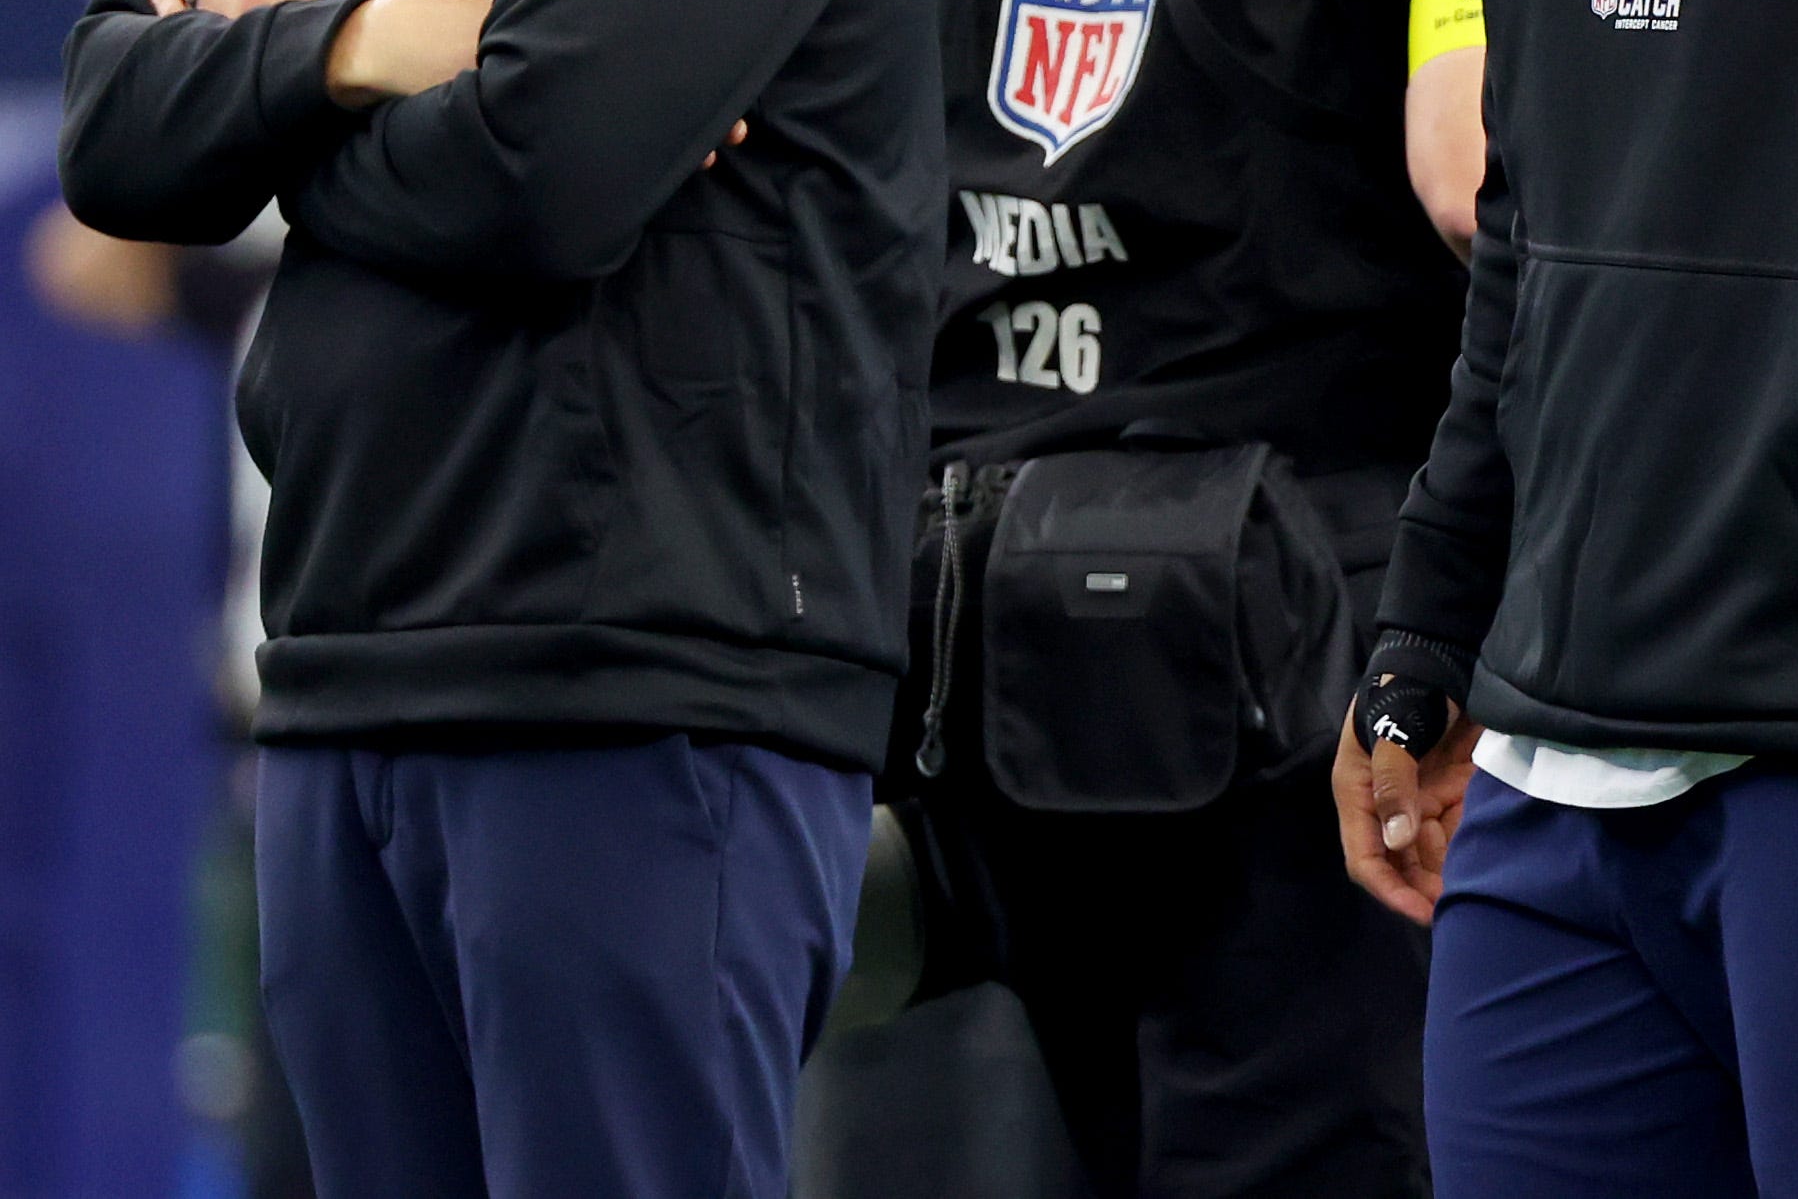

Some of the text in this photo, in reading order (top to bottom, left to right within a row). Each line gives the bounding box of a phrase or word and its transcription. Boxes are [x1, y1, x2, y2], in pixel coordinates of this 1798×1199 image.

[1614, 18, 1679, 31] INTERCEPT CANCER
[1013, 15, 1126, 128] NFL
[959, 190, 1128, 277] MEDIA
[977, 301, 1102, 394] 126
